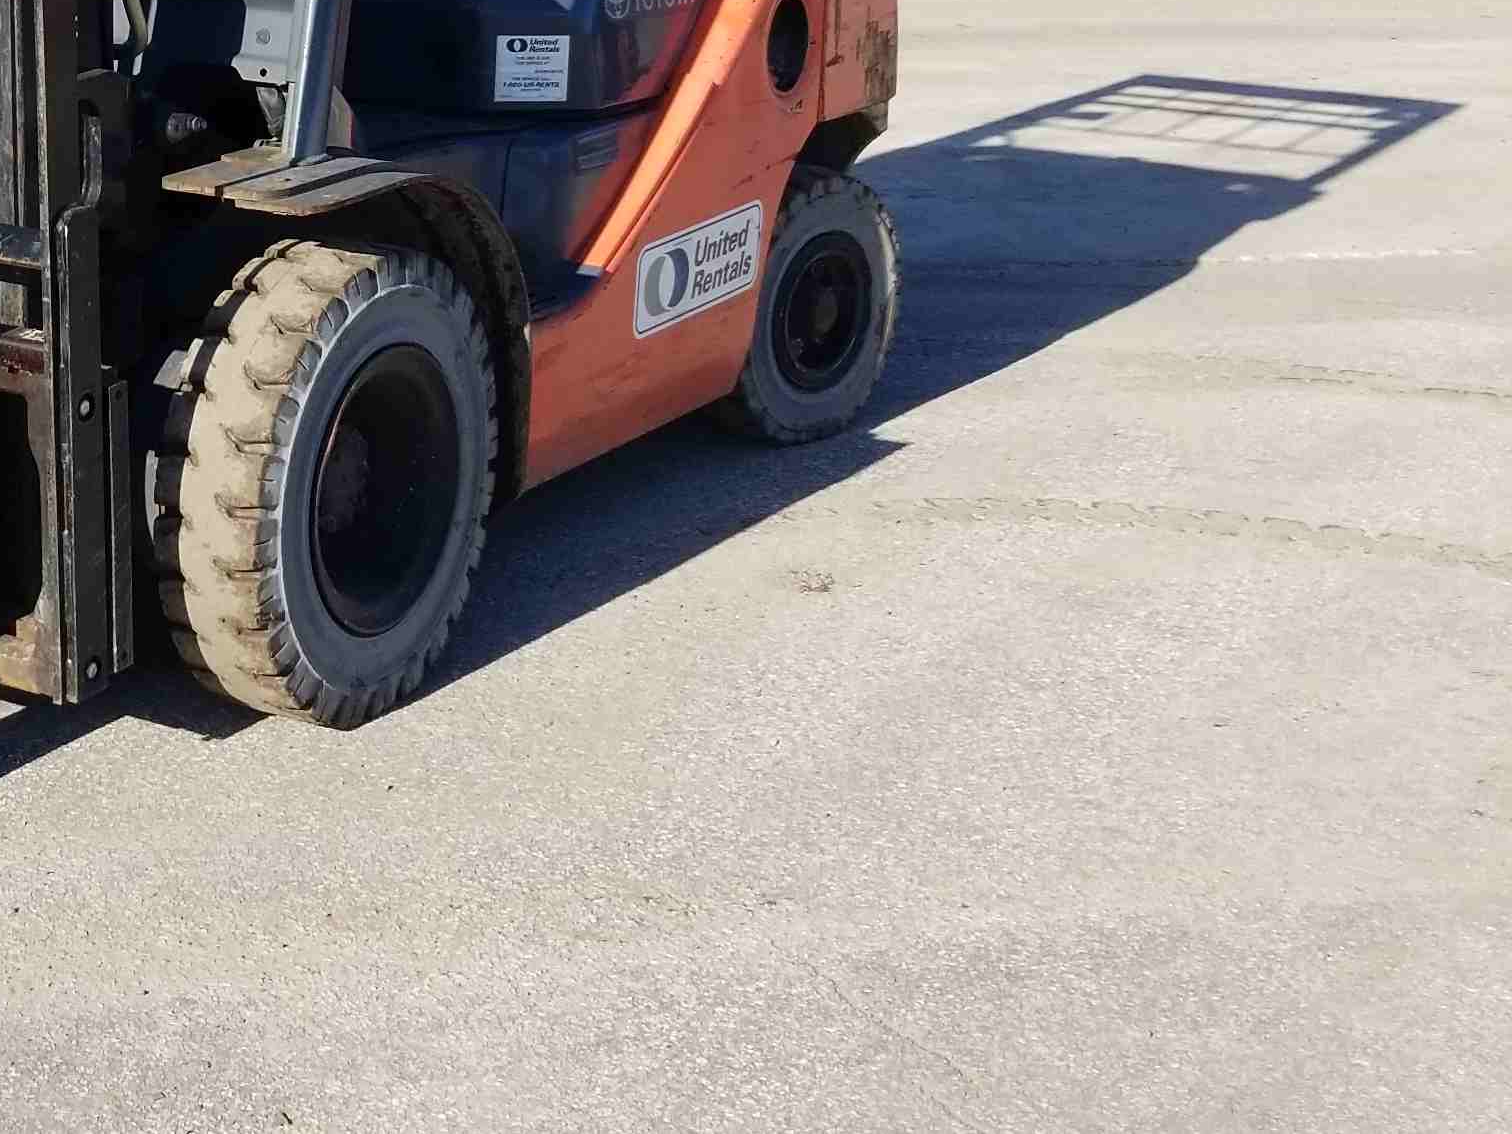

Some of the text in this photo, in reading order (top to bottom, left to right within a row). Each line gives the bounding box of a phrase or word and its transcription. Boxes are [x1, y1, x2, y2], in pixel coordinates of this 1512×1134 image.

[529, 38, 560, 46] United
[694, 219, 750, 267] United
[691, 251, 753, 300] Rentals
